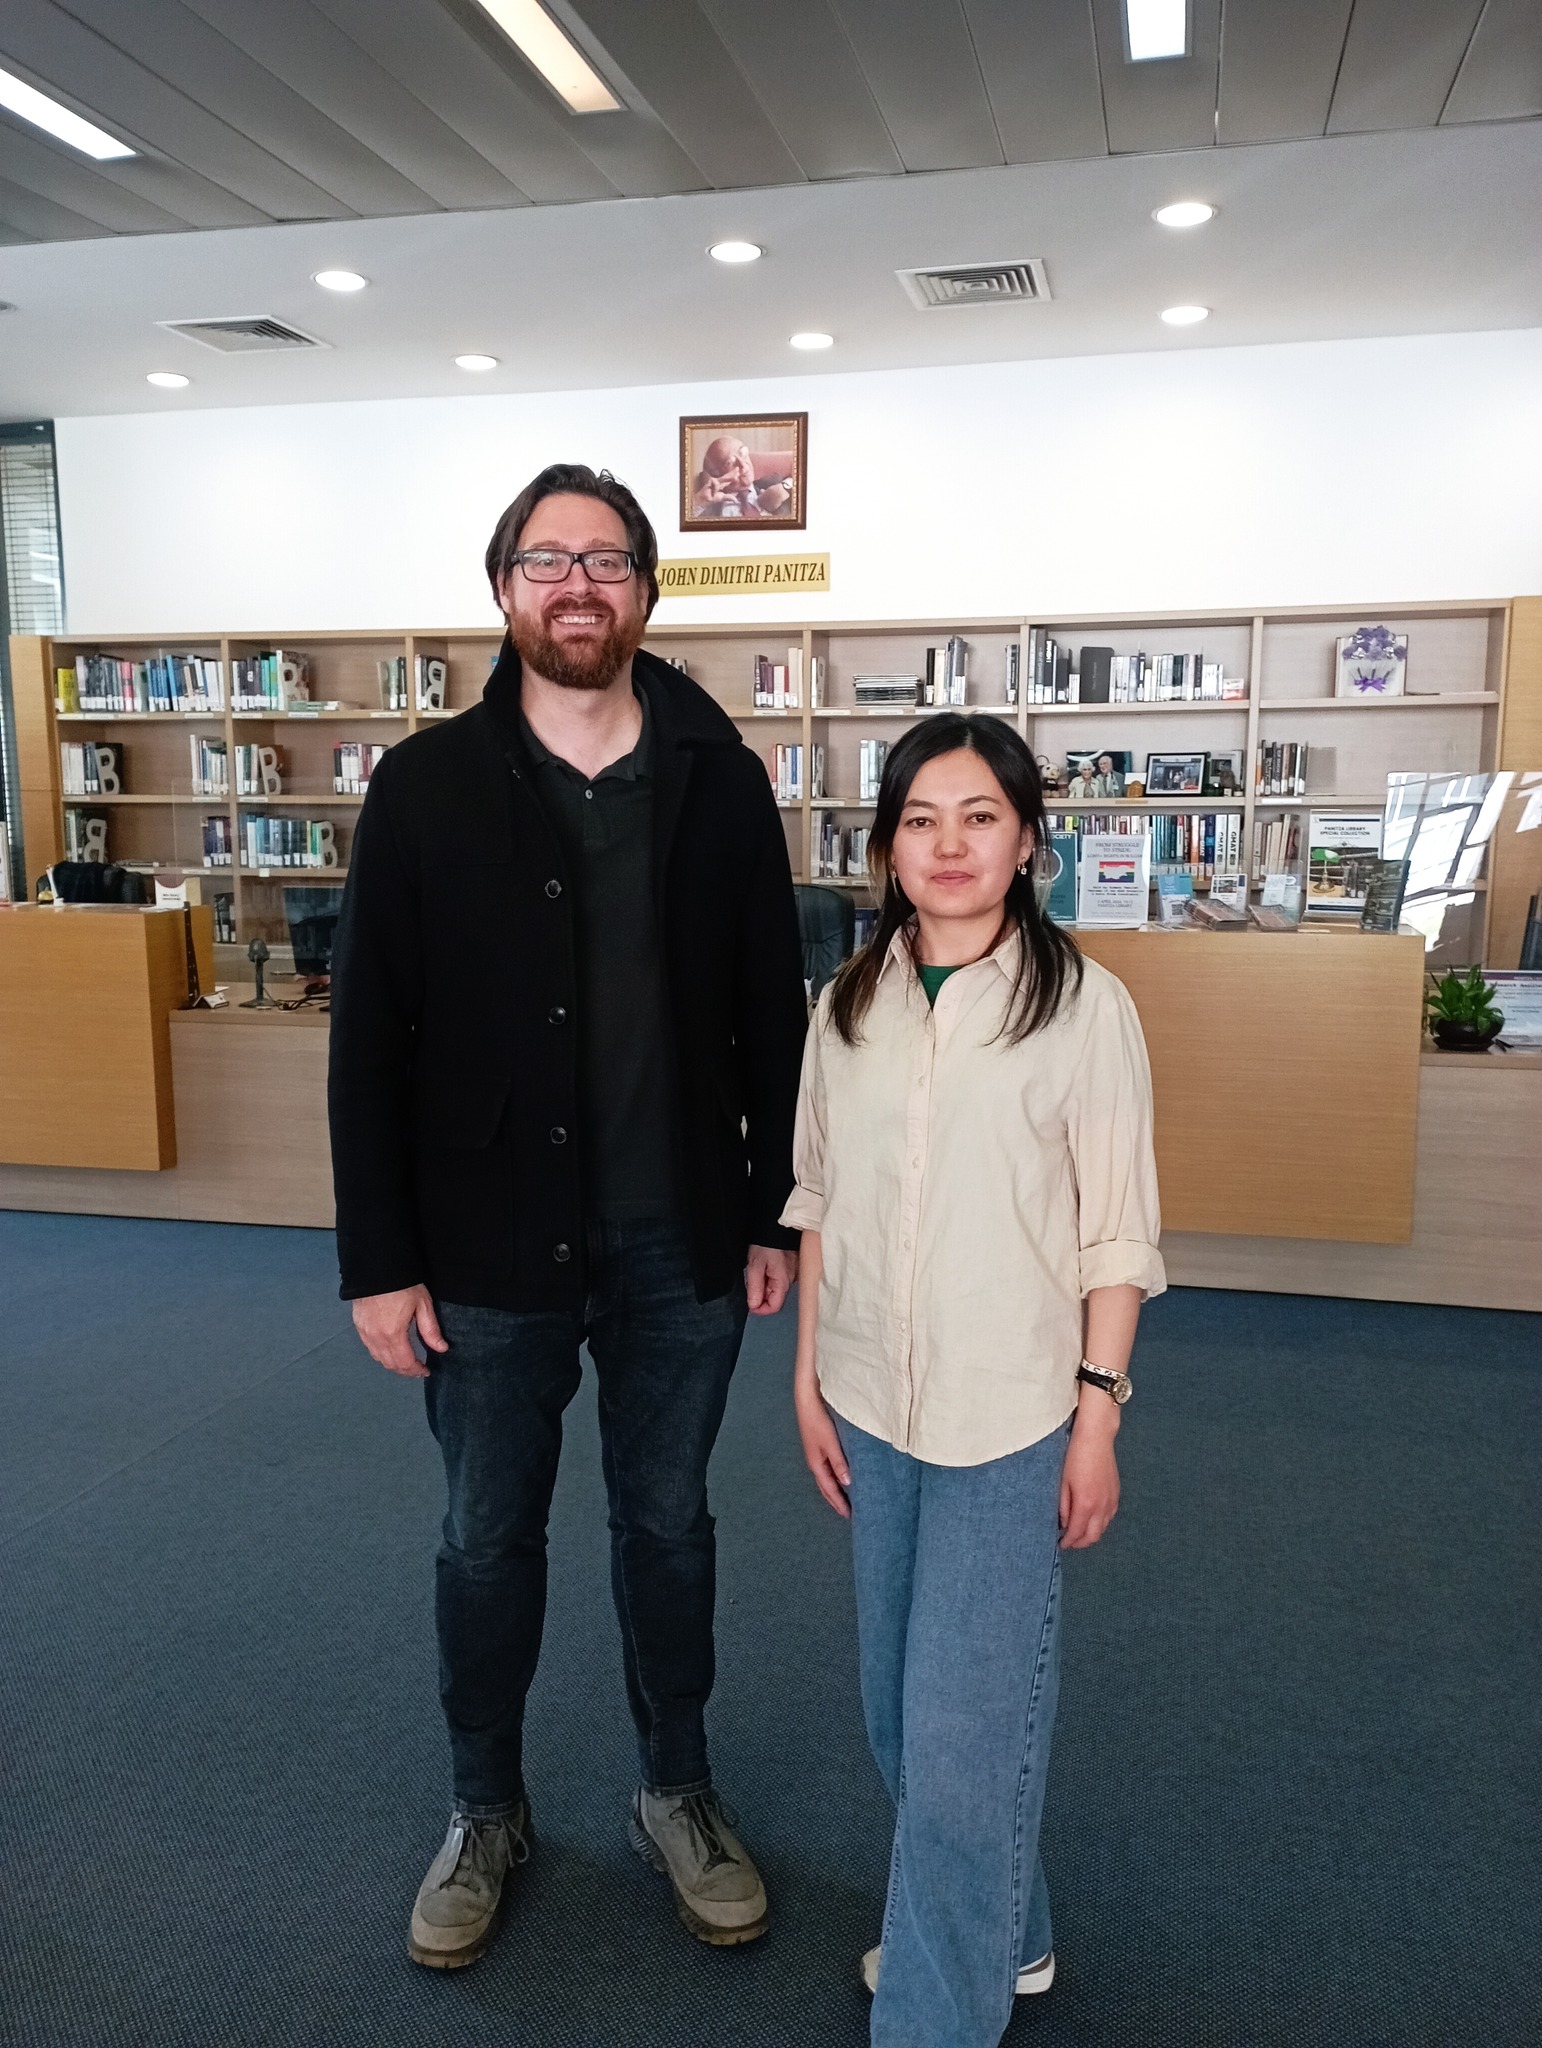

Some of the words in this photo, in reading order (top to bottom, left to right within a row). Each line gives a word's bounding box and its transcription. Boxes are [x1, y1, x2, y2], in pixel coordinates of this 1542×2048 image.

[658, 567, 697, 587] JOHN
[700, 565, 761, 585] DIMITRI
[763, 562, 825, 583] PANITZA
